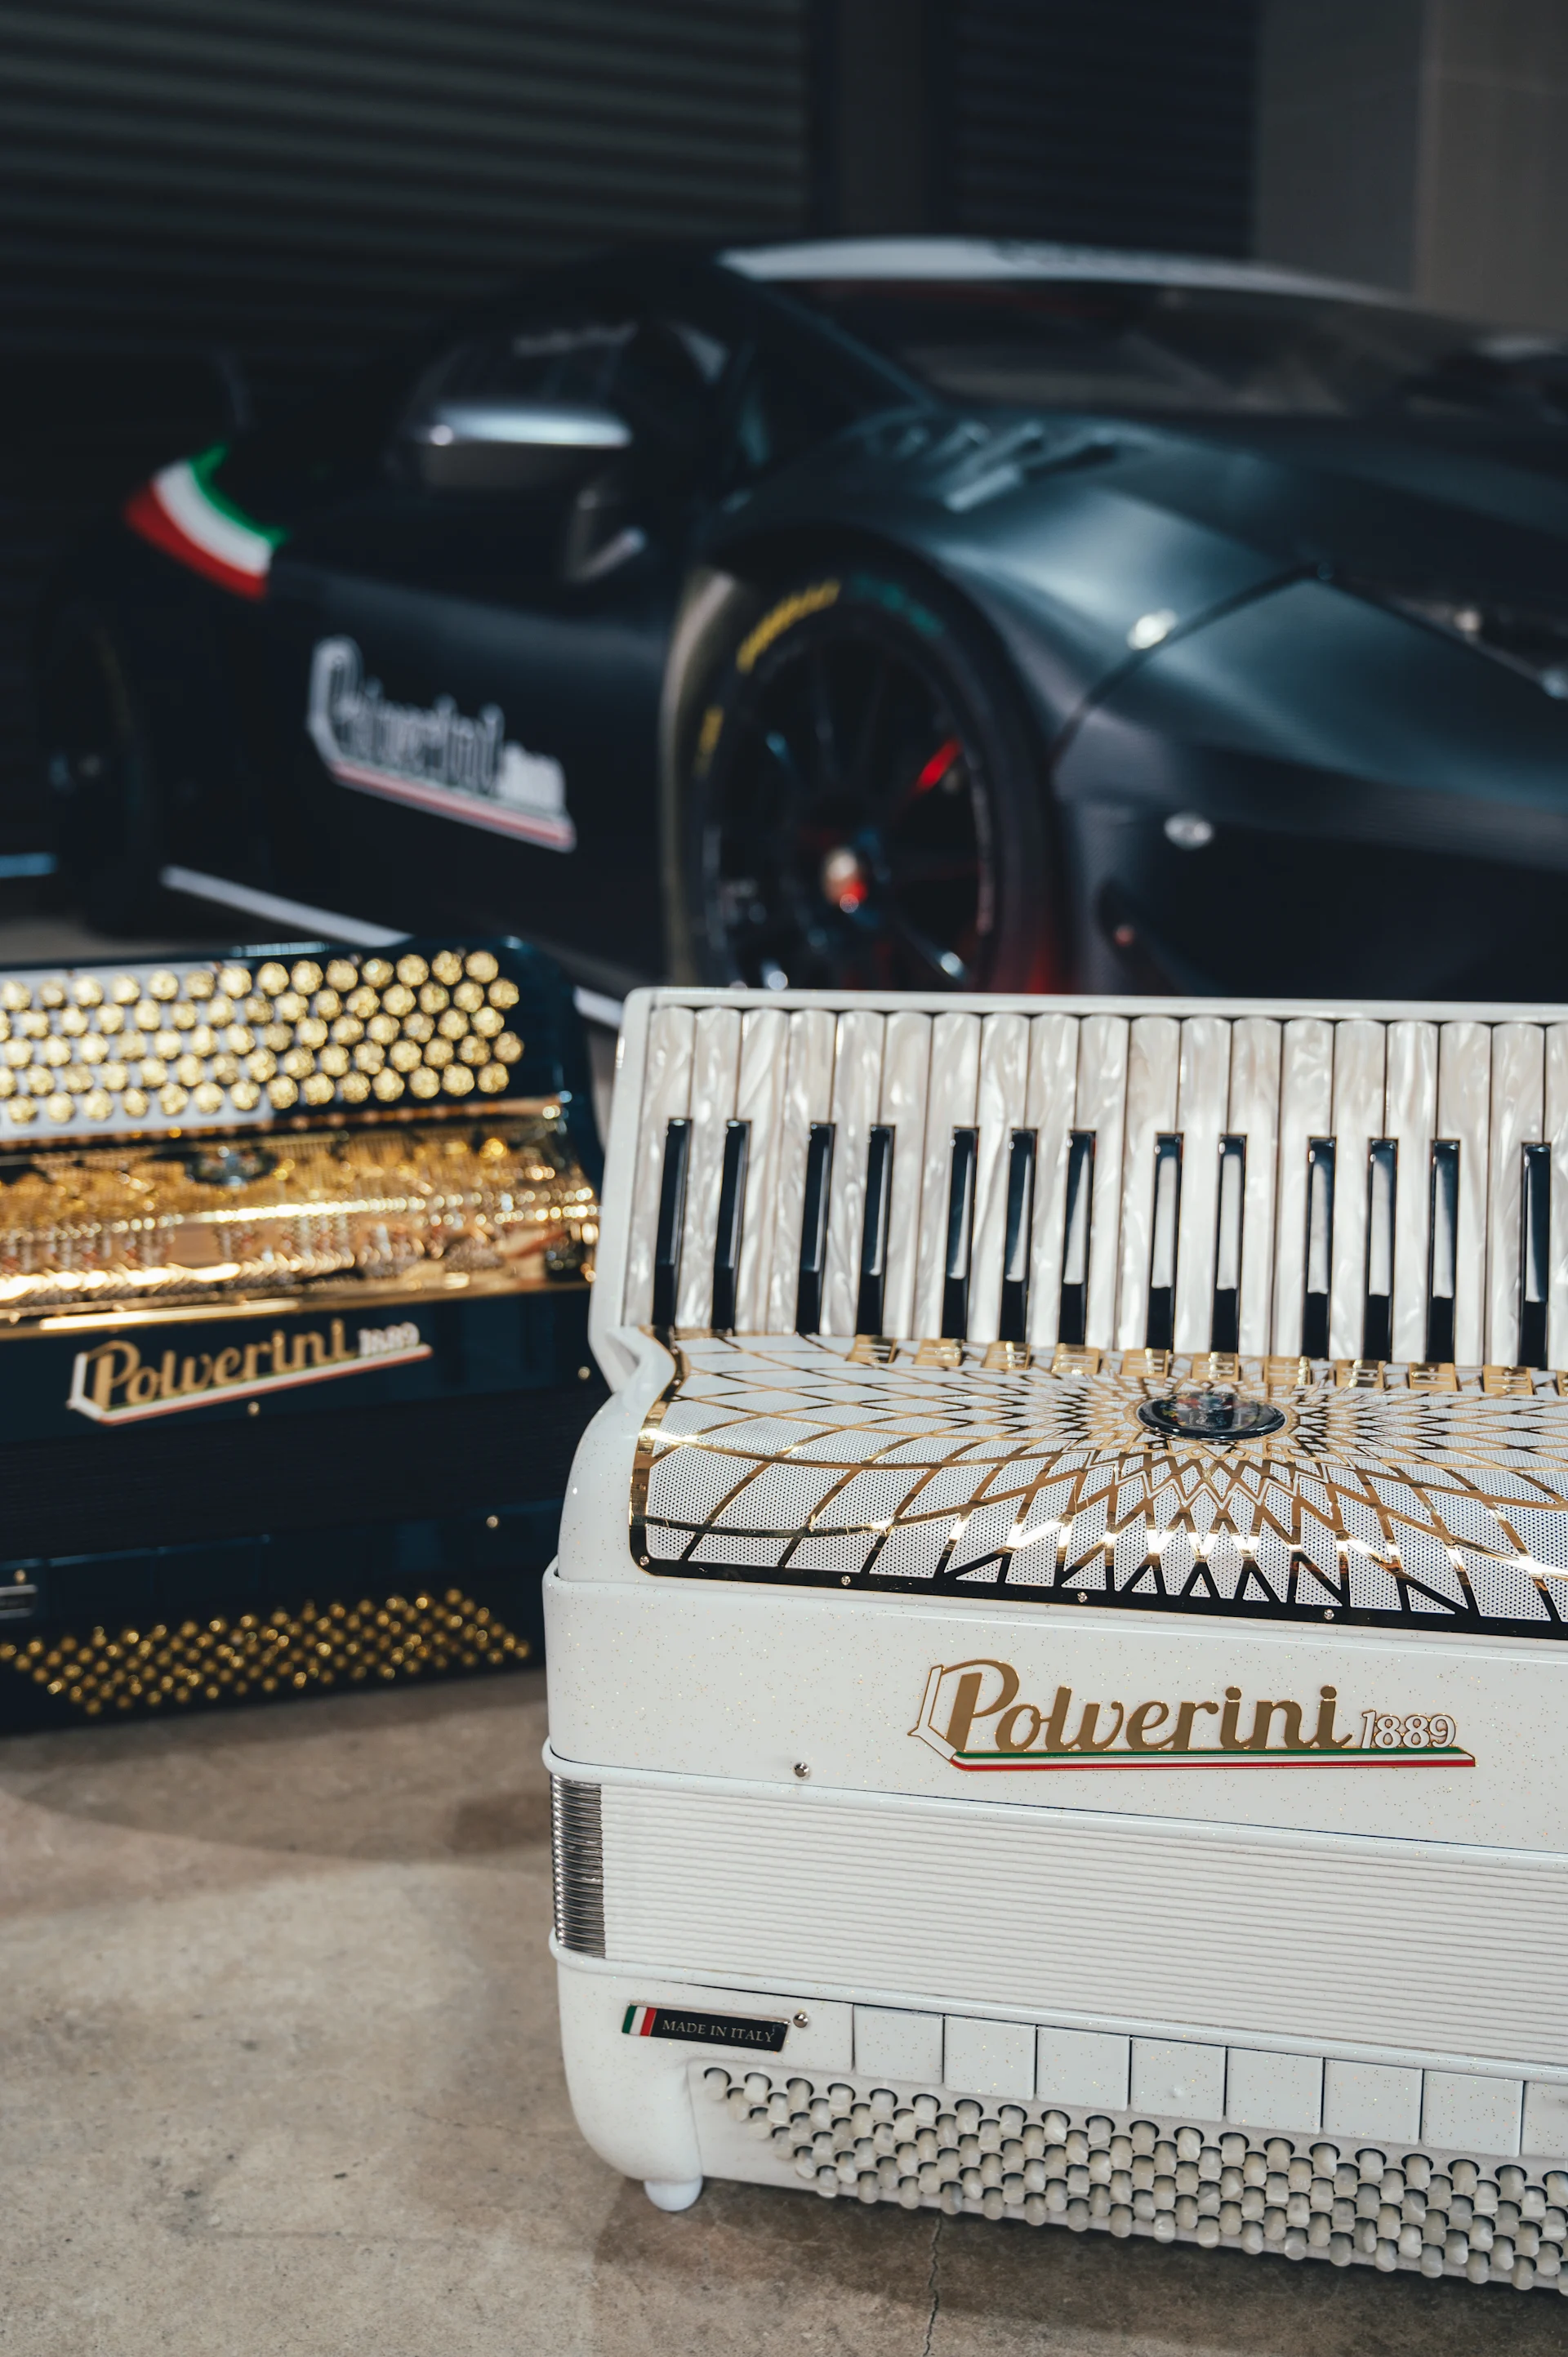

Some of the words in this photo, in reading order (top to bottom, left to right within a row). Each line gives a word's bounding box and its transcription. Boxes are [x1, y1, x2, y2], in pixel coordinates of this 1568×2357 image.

[85, 1317, 354, 1411] Polverini
[936, 1658, 1353, 1752] Polverini
[1361, 1709, 1458, 1750] 1889
[662, 2019, 706, 2034] MADE
[710, 2025, 727, 2037] IN
[731, 2027, 775, 2043] ITALY
